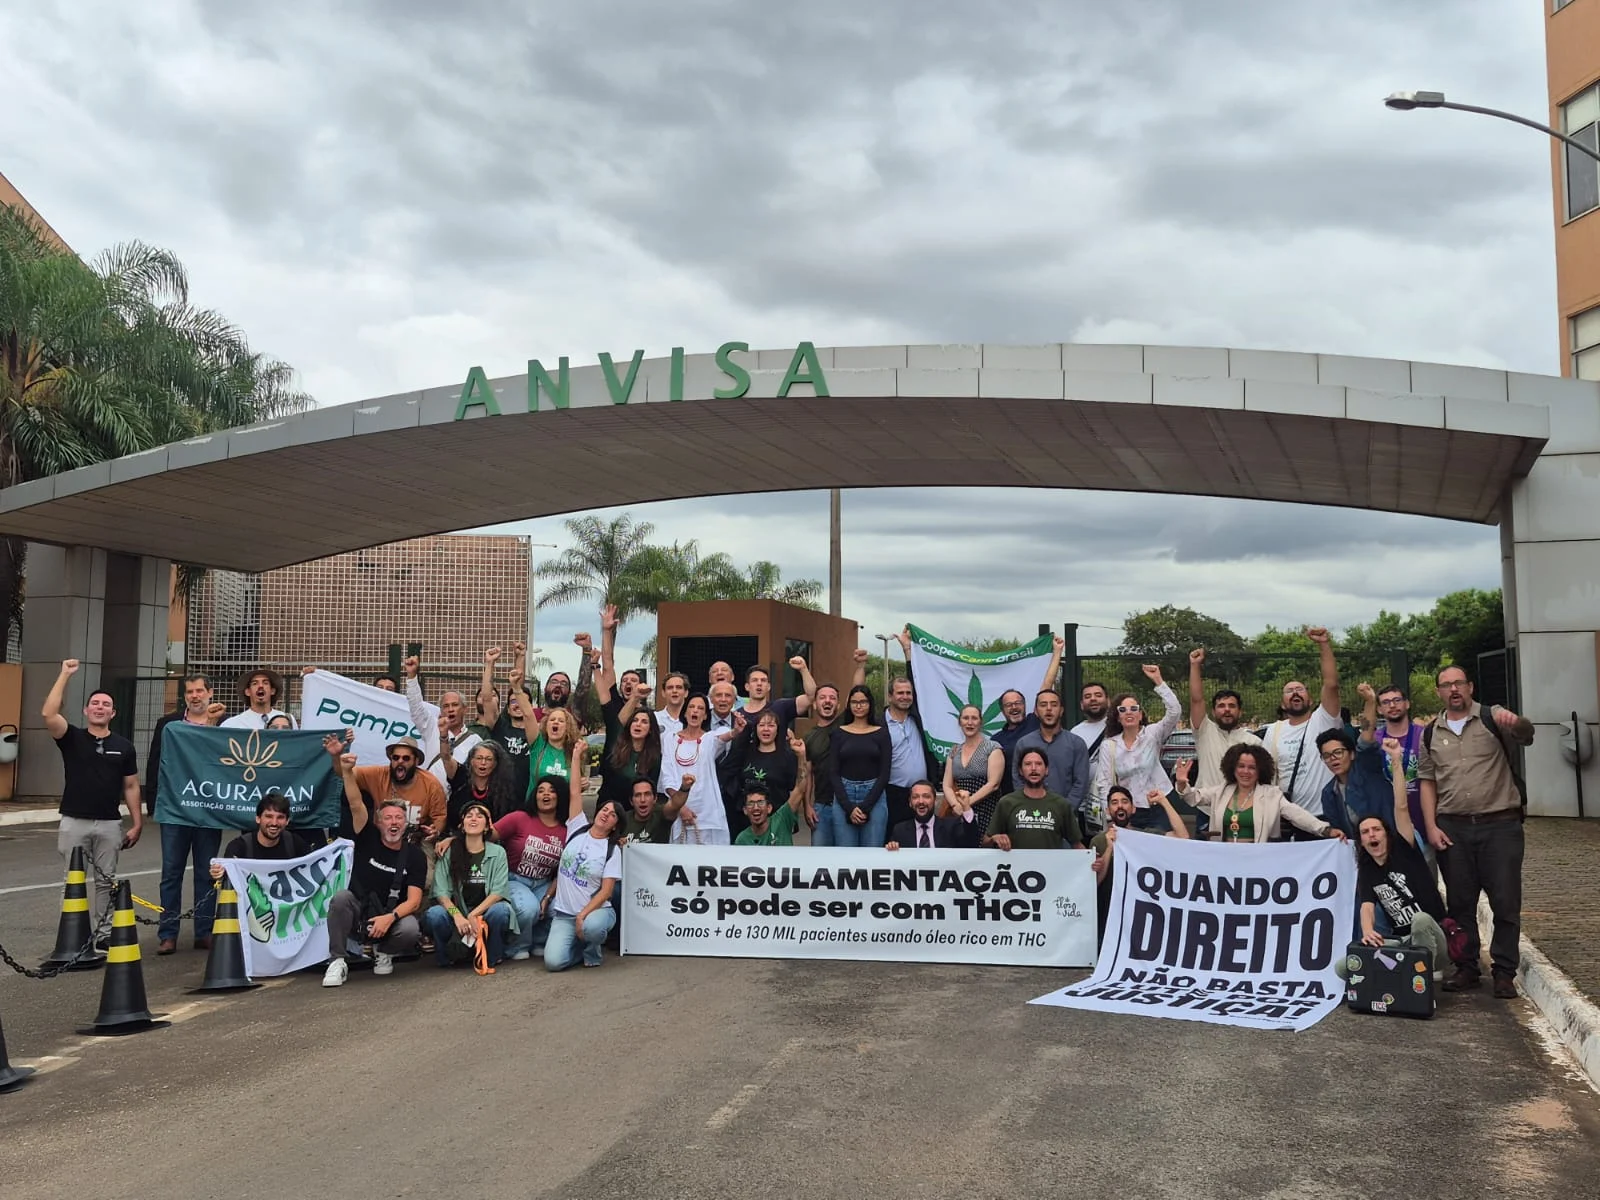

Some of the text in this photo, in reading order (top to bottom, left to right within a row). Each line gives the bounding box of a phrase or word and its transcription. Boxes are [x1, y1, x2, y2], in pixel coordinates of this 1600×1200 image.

[454, 341, 831, 422] ANVISA
[180, 800, 224, 810] ASSOCIAÇÃO
[666, 864, 1046, 900] A REGULAMENTAÇÃO
[1136, 866, 1299, 905] QUANDO
[1312, 871, 1338, 900] O
[671, 891, 1042, 922] só pode ser com THC!
[666, 924, 1047, 947] Somos + de 130 MIL pacientes usando óleo rico em THC
[1128, 900, 1335, 974] DIREITO
[1119, 967, 1337, 1000] NÃO BASTA,
[1064, 987, 1312, 1020] JUSTIÇA!
